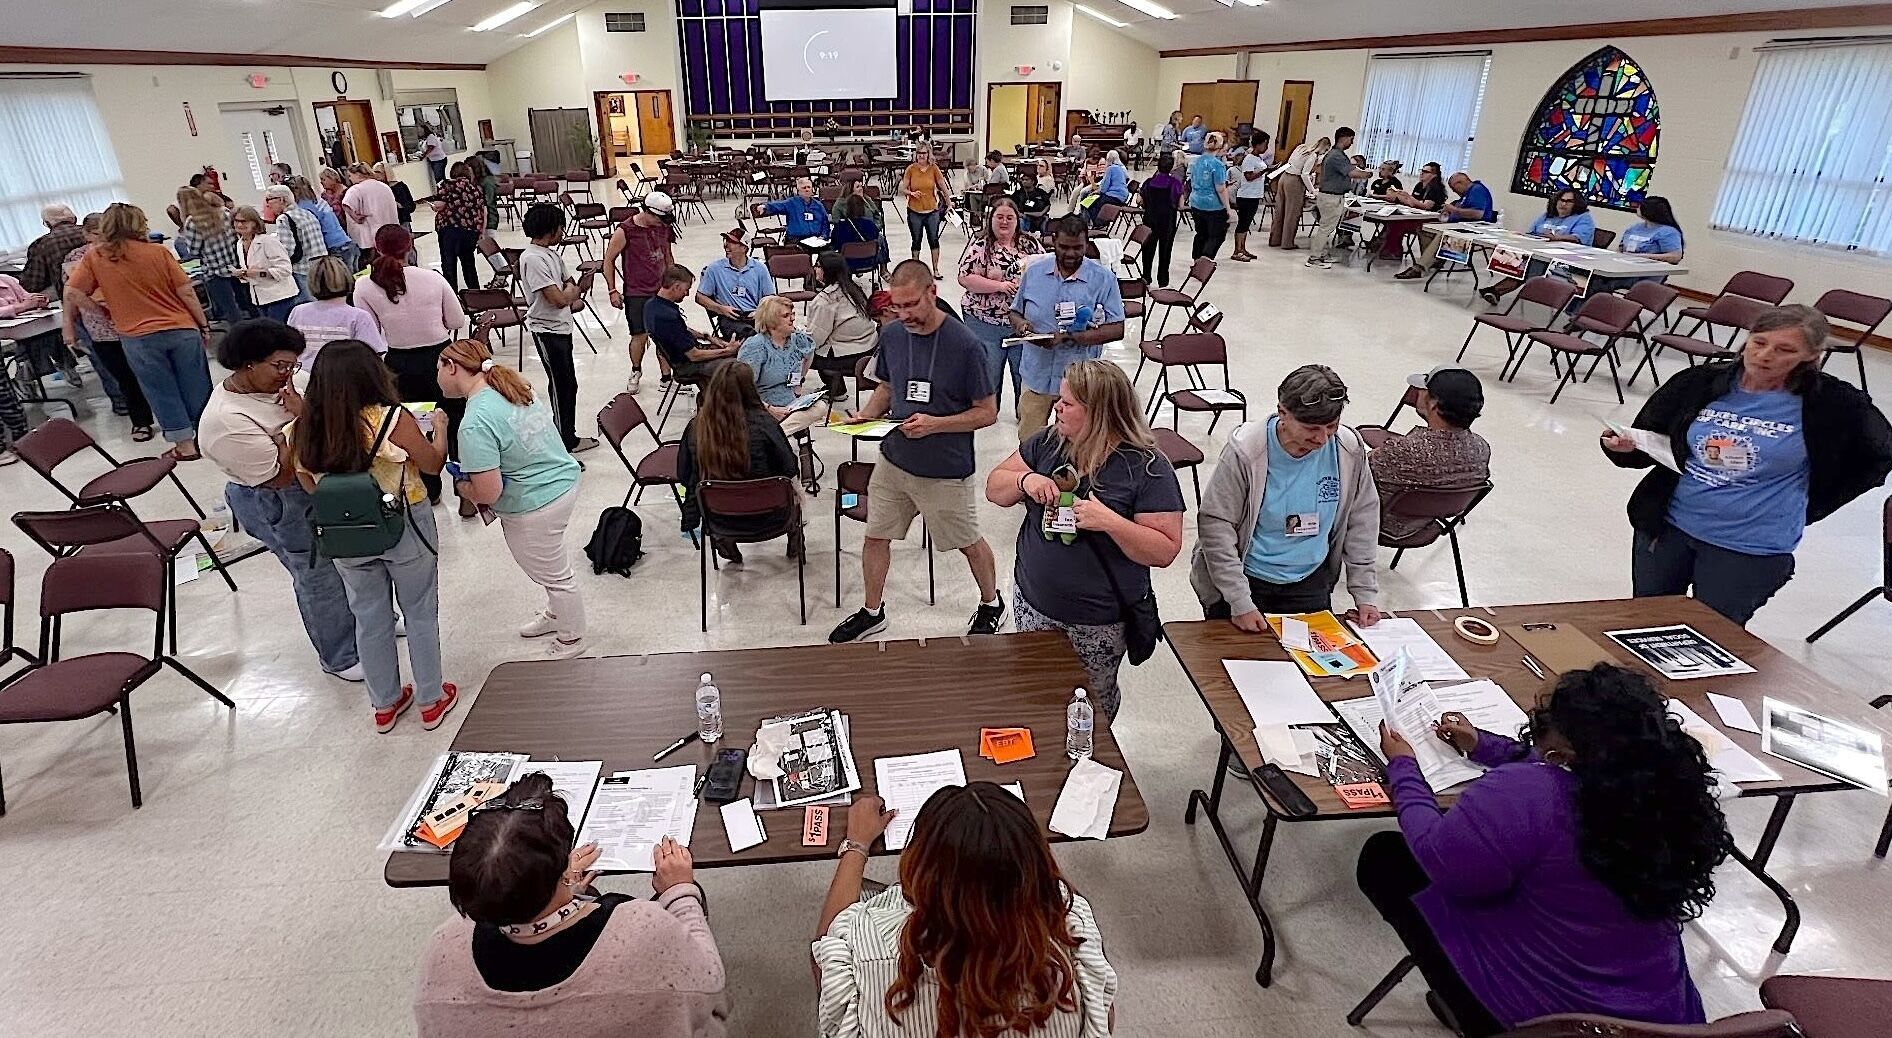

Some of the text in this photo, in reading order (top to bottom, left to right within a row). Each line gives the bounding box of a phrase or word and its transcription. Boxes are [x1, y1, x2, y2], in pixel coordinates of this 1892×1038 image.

[819, 50, 839, 60] 9:19
[1741, 416, 1795, 433] CIRCLES
[813, 808, 824, 834] PASS
